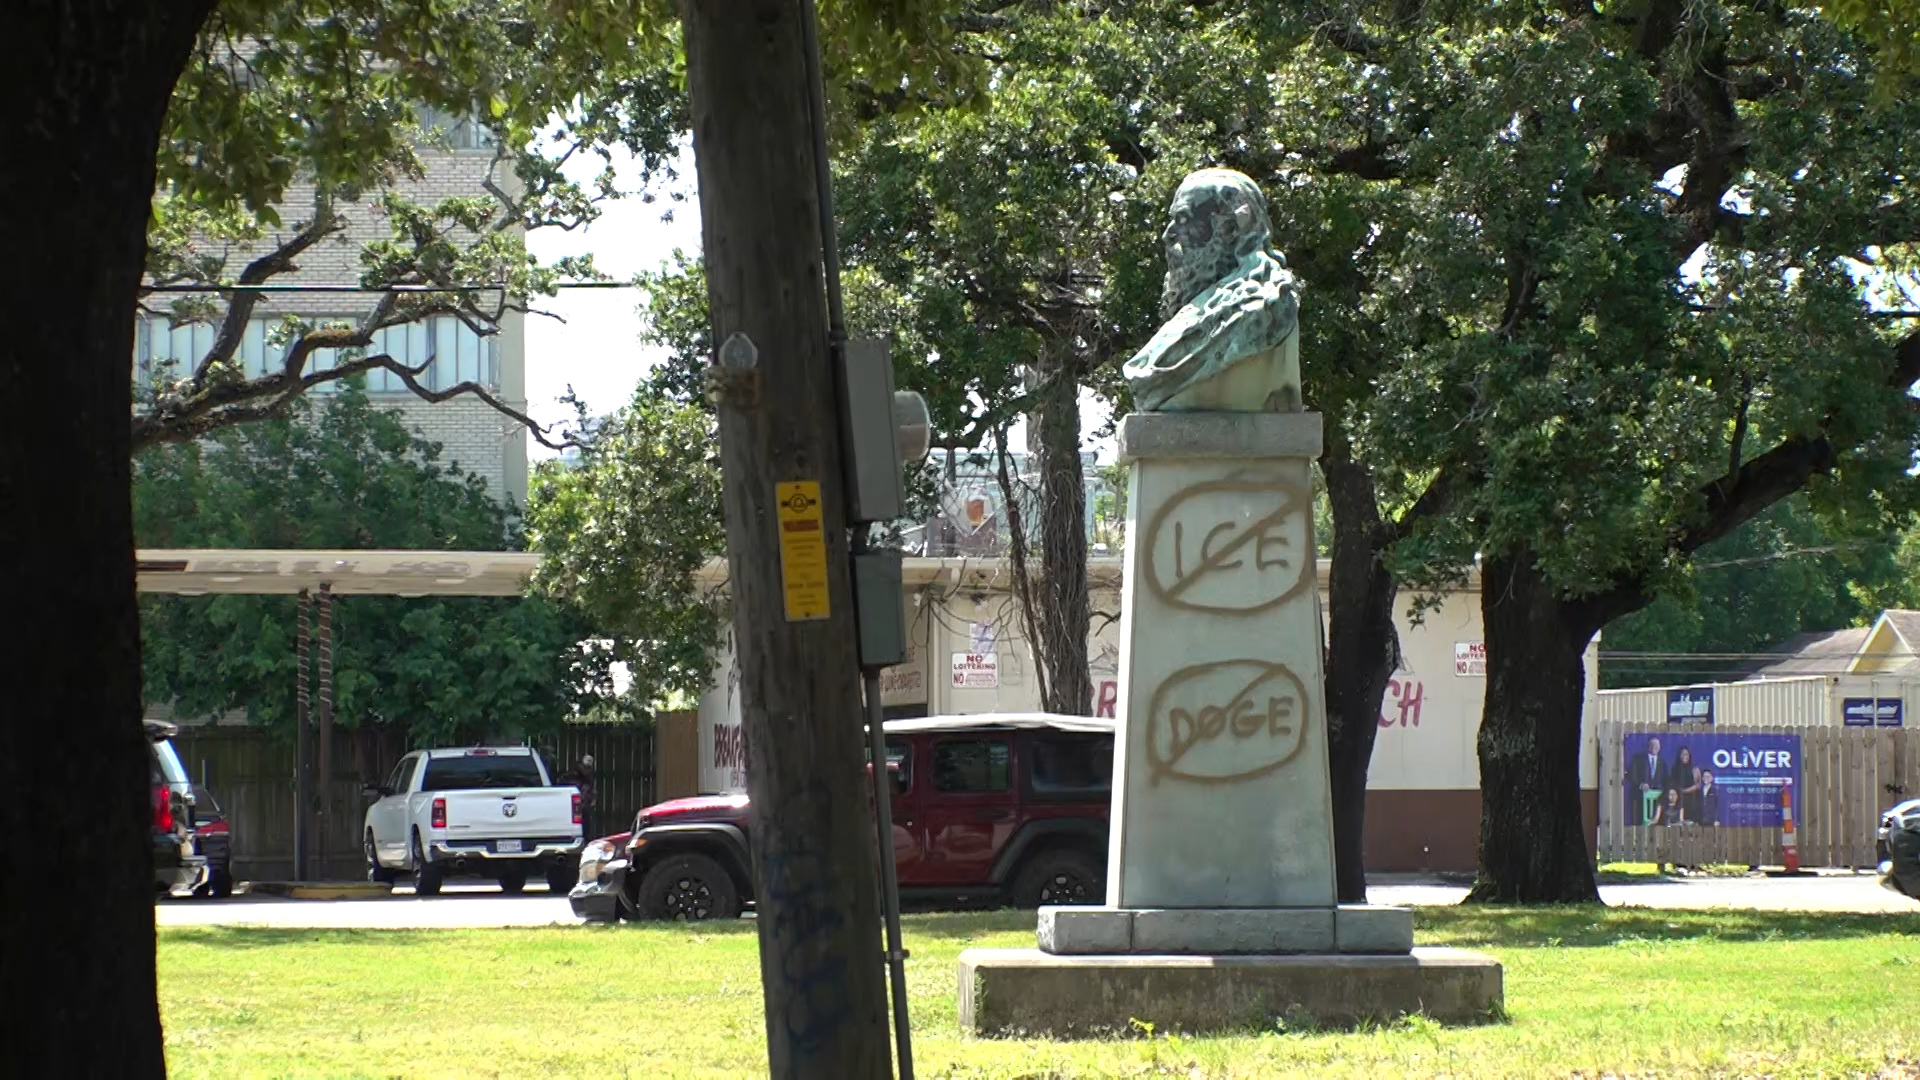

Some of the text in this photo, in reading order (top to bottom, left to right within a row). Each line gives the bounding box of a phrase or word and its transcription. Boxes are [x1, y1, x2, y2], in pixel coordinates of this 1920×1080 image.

[1175, 517, 1290, 579] ICE
[966, 654, 983, 663] NO
[953, 673, 964, 684] NO
[1169, 696, 1294, 751] DOGE
